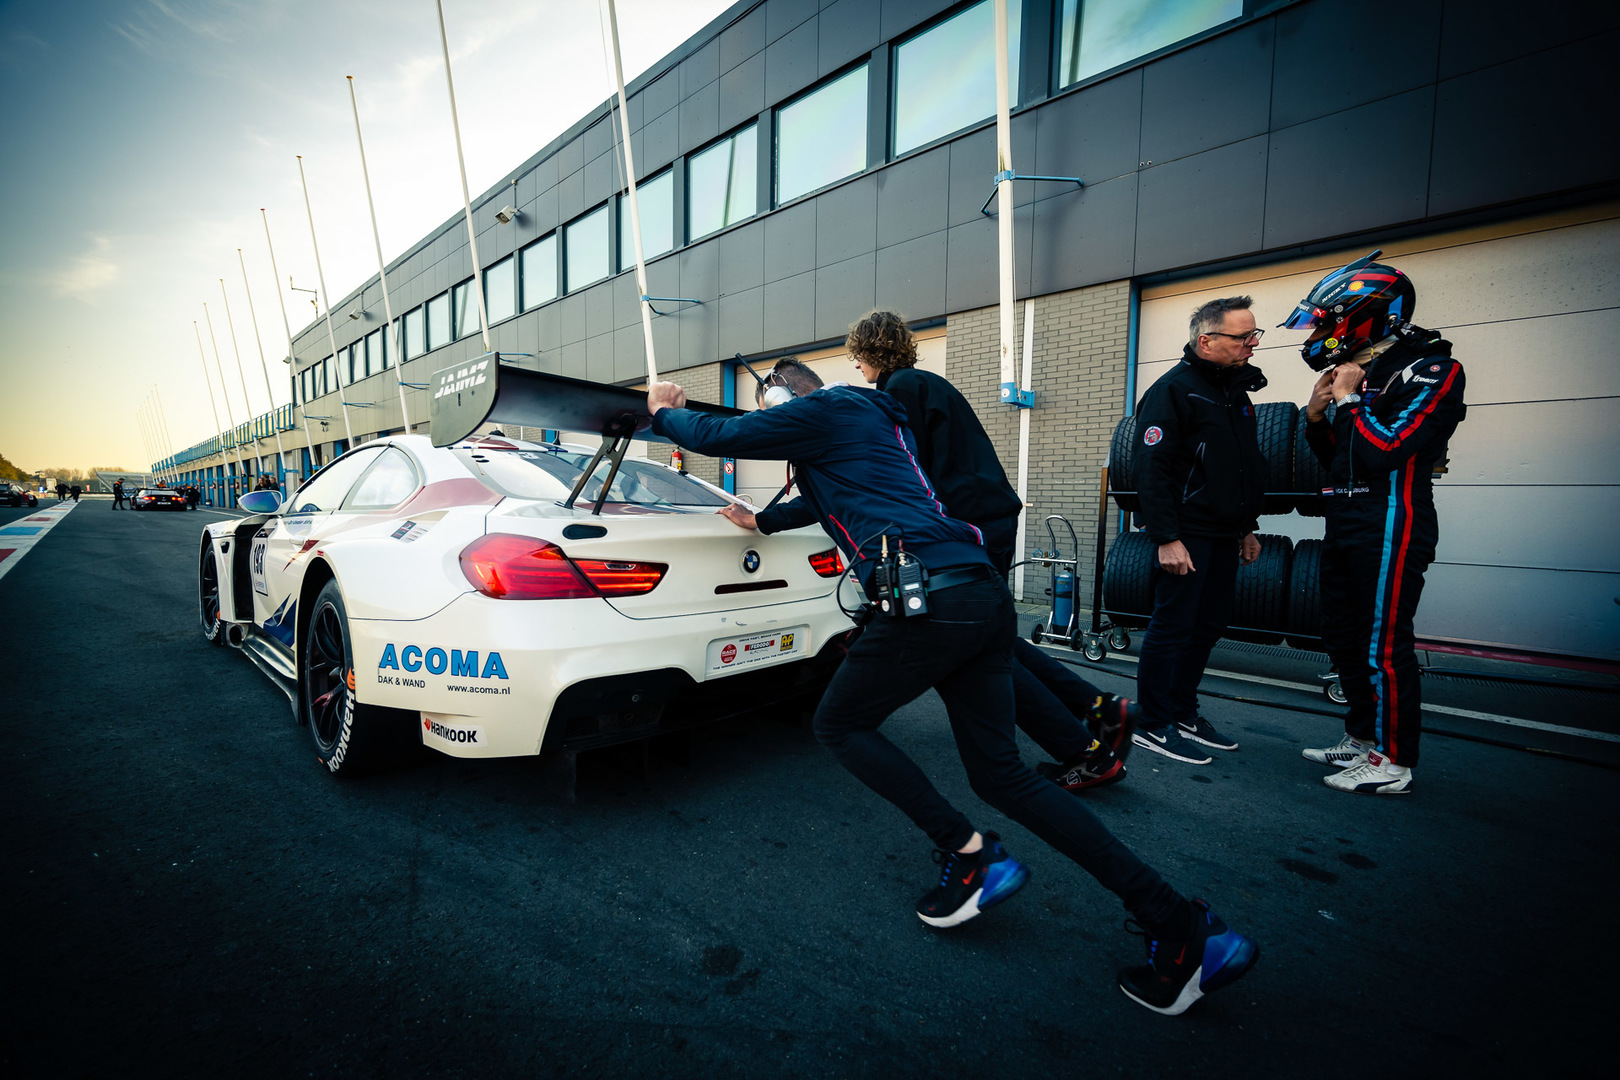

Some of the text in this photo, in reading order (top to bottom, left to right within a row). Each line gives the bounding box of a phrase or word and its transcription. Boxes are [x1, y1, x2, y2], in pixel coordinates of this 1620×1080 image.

[1321, 282, 1347, 303] NICKY
[379, 643, 510, 680] ACOMA
[378, 675, 425, 689] DAK & WAND
[447, 684, 511, 695] www.acoma.nl
